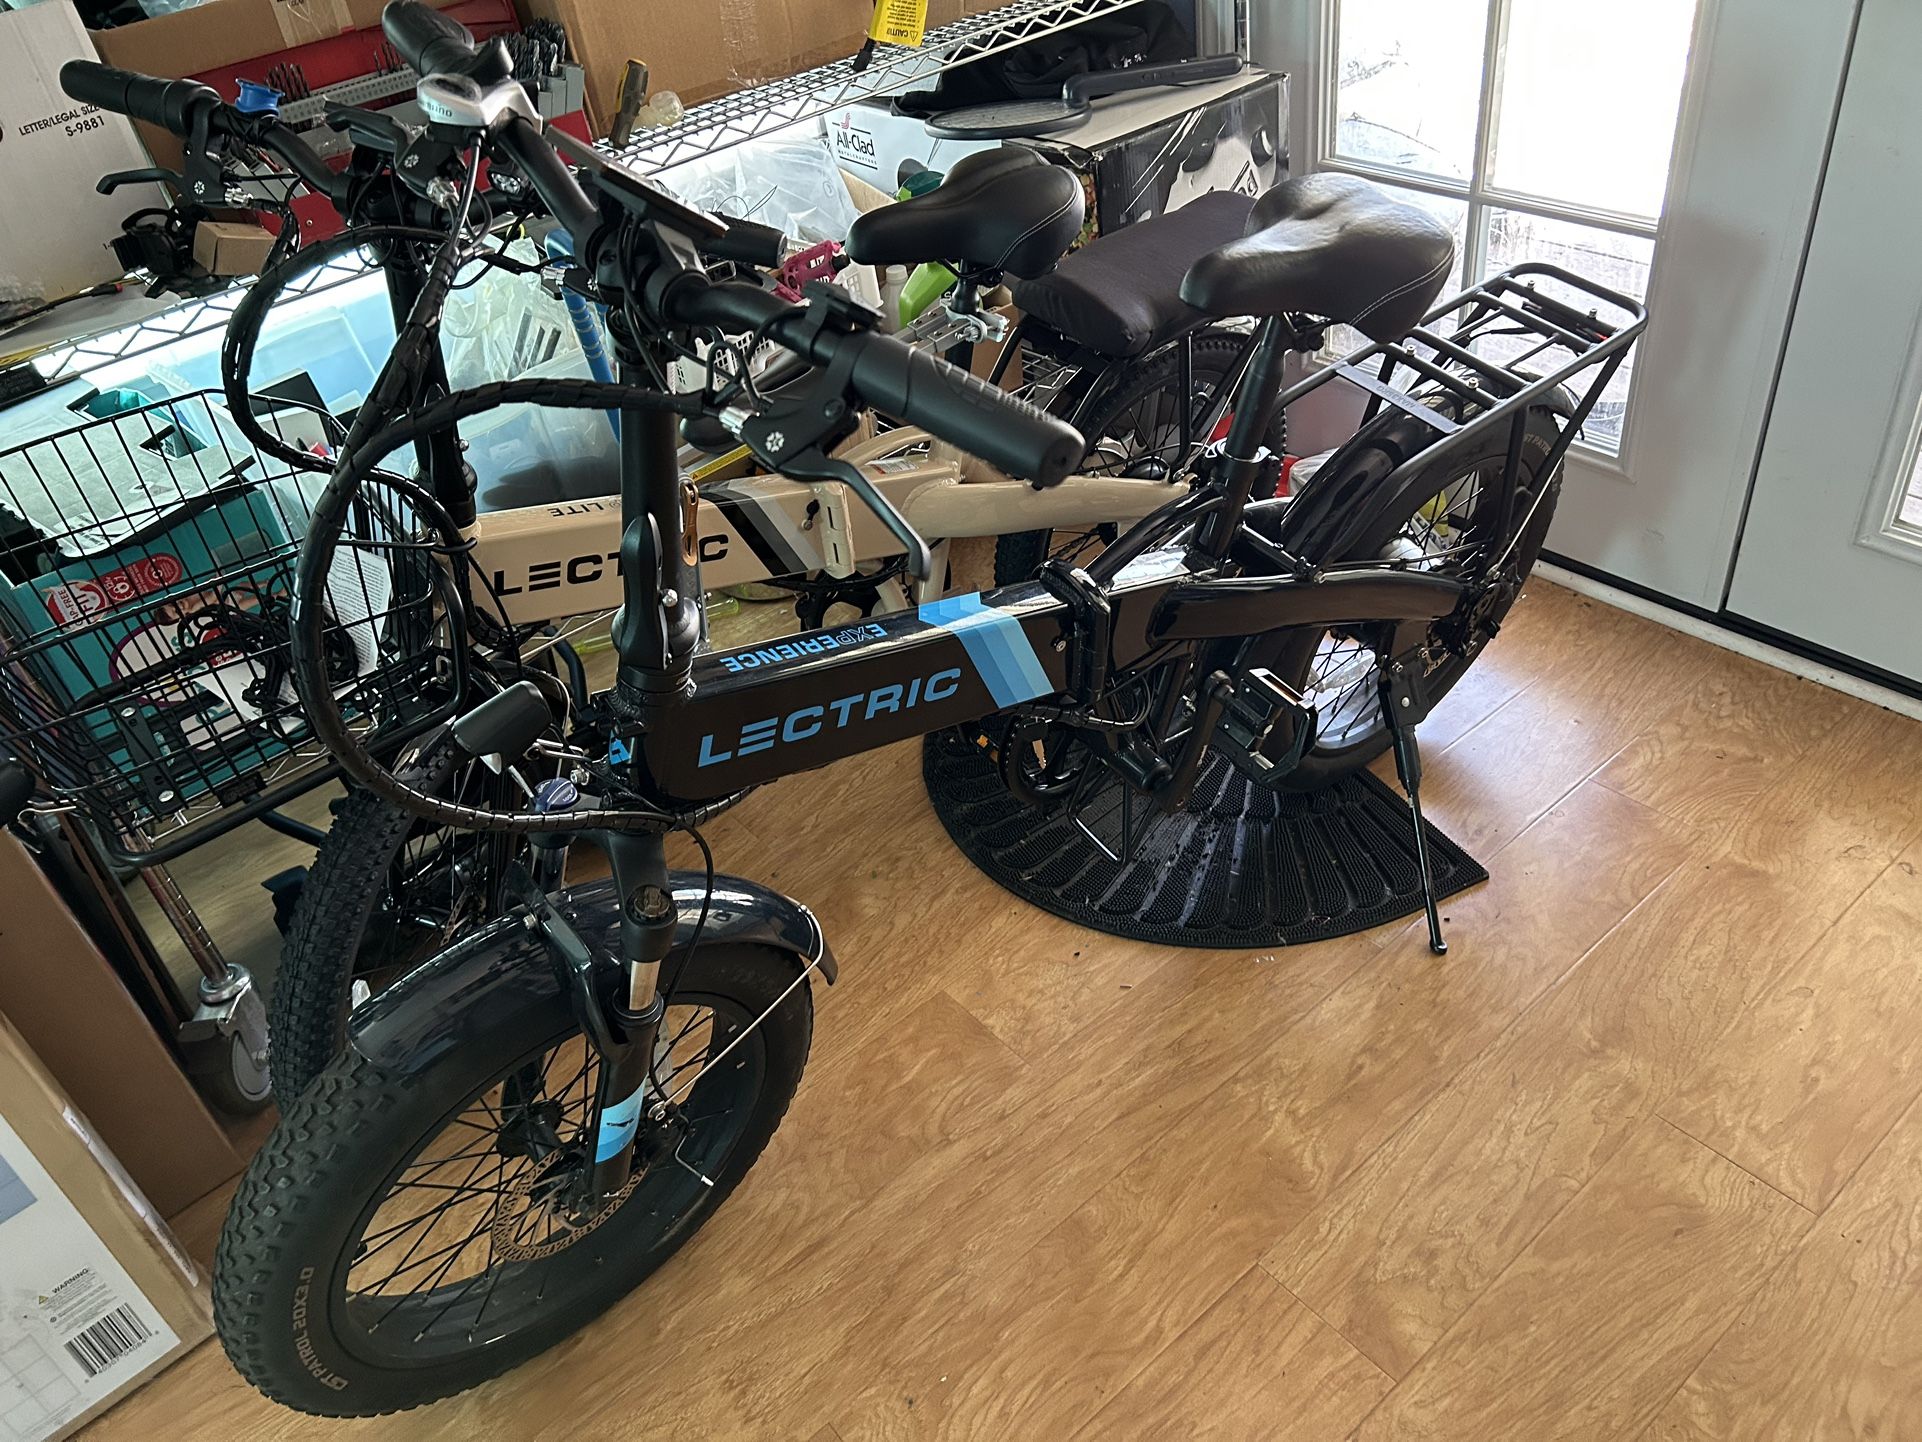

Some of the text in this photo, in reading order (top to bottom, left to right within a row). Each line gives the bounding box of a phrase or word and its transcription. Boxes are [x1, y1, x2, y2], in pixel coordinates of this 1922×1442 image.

[19, 109, 81, 136] LETTER/LEGAL
[65, 115, 104, 137] S-9881
[837, 130, 876, 157] All-Clad
[549, 503, 604, 517] LITE
[494, 534, 729, 597] LECTC
[719, 623, 888, 673] EXPERIENCE
[698, 668, 961, 768] LECTRIC
[52, 1268, 89, 1294] WARNING
[292, 1267, 315, 1331] 20X3.0
[295, 1330, 327, 1378] PATROL
